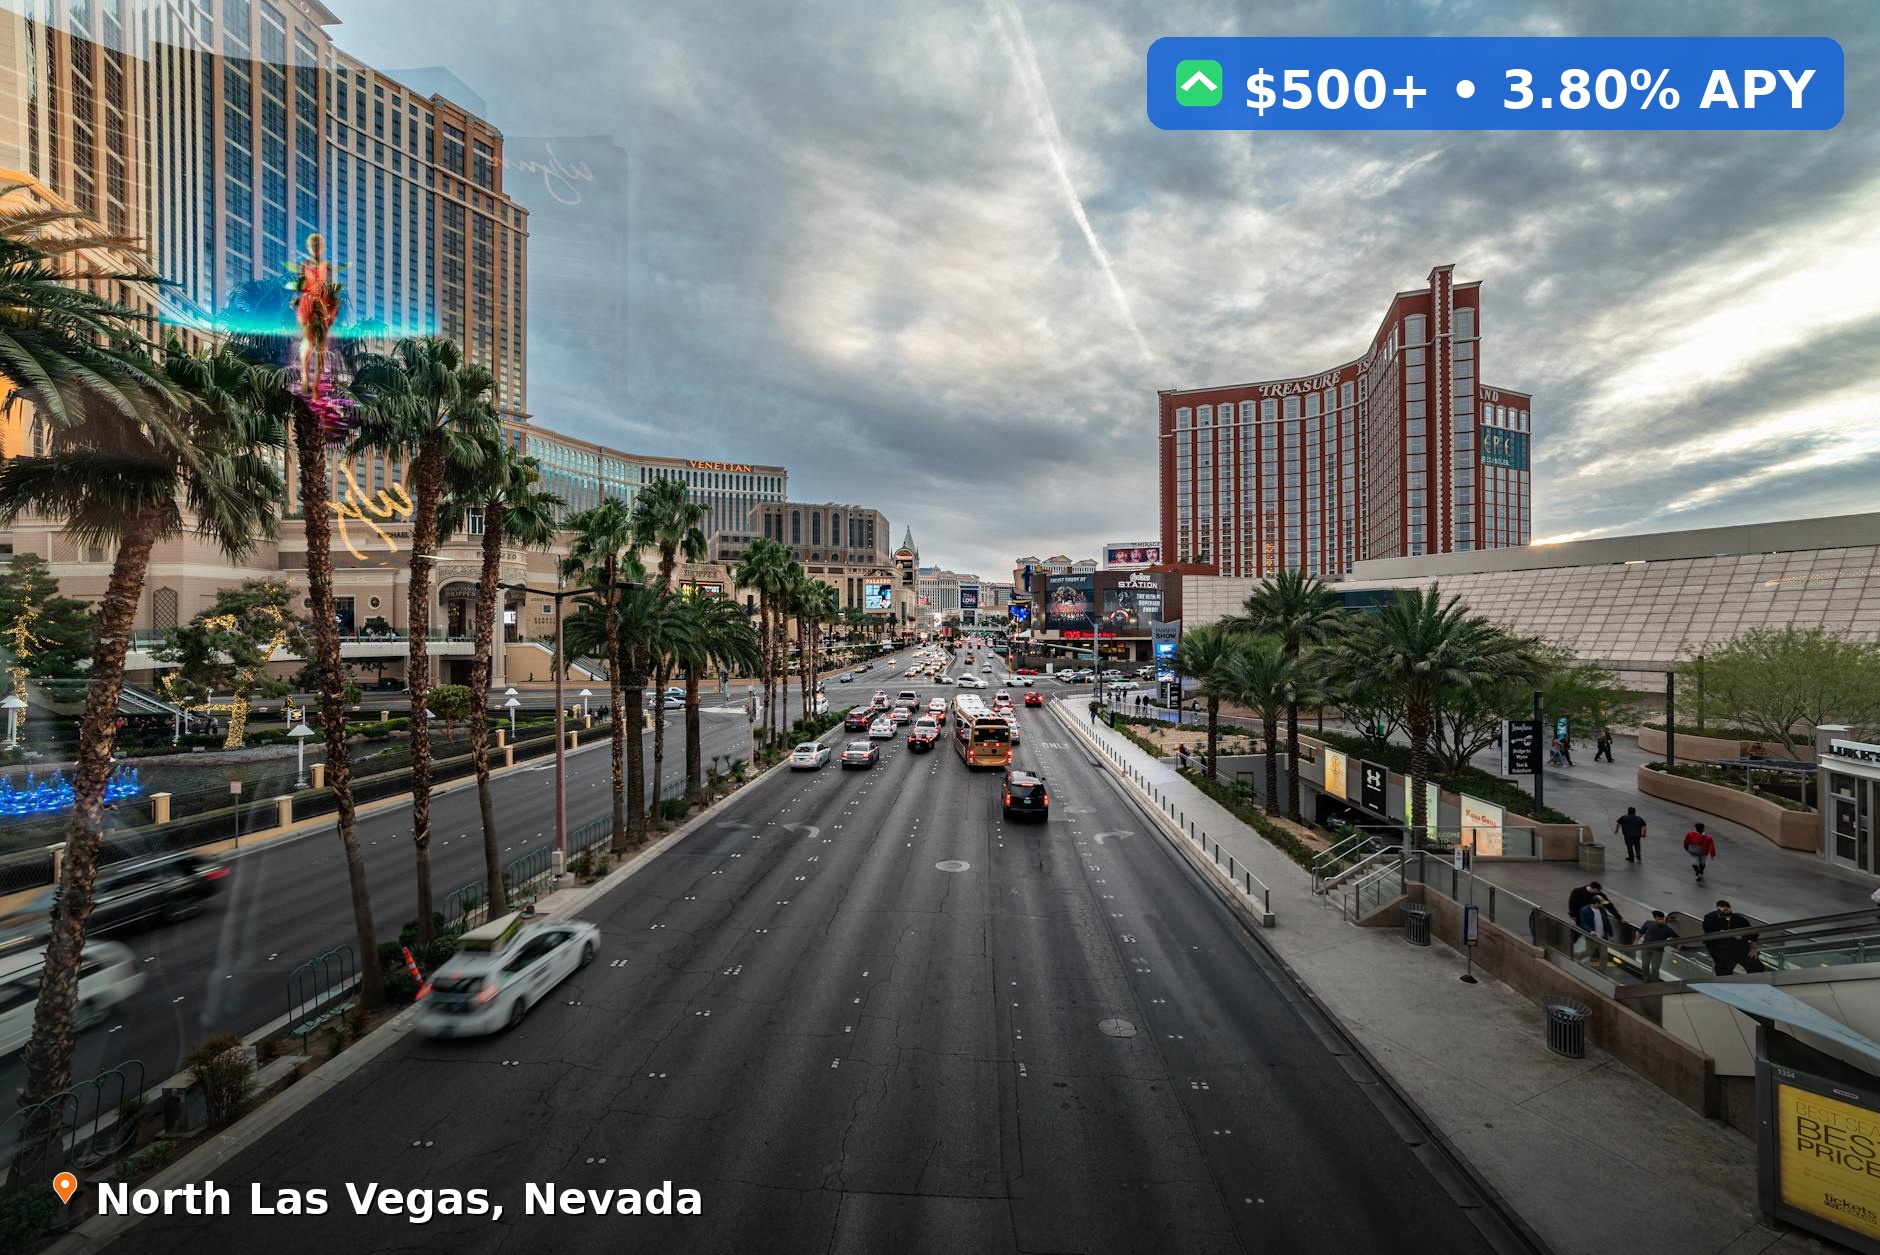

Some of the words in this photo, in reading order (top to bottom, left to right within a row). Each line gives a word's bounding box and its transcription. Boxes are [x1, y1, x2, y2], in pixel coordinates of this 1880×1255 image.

[1259, 372, 1341, 398] TREASURE
[689, 460, 752, 473] VENETIAN
[1063, 631, 1081, 639] CVS
[1796, 1101, 1841, 1127] BEST
[1797, 1116, 1880, 1159] BES
[1824, 1192, 1877, 1219] tickets
